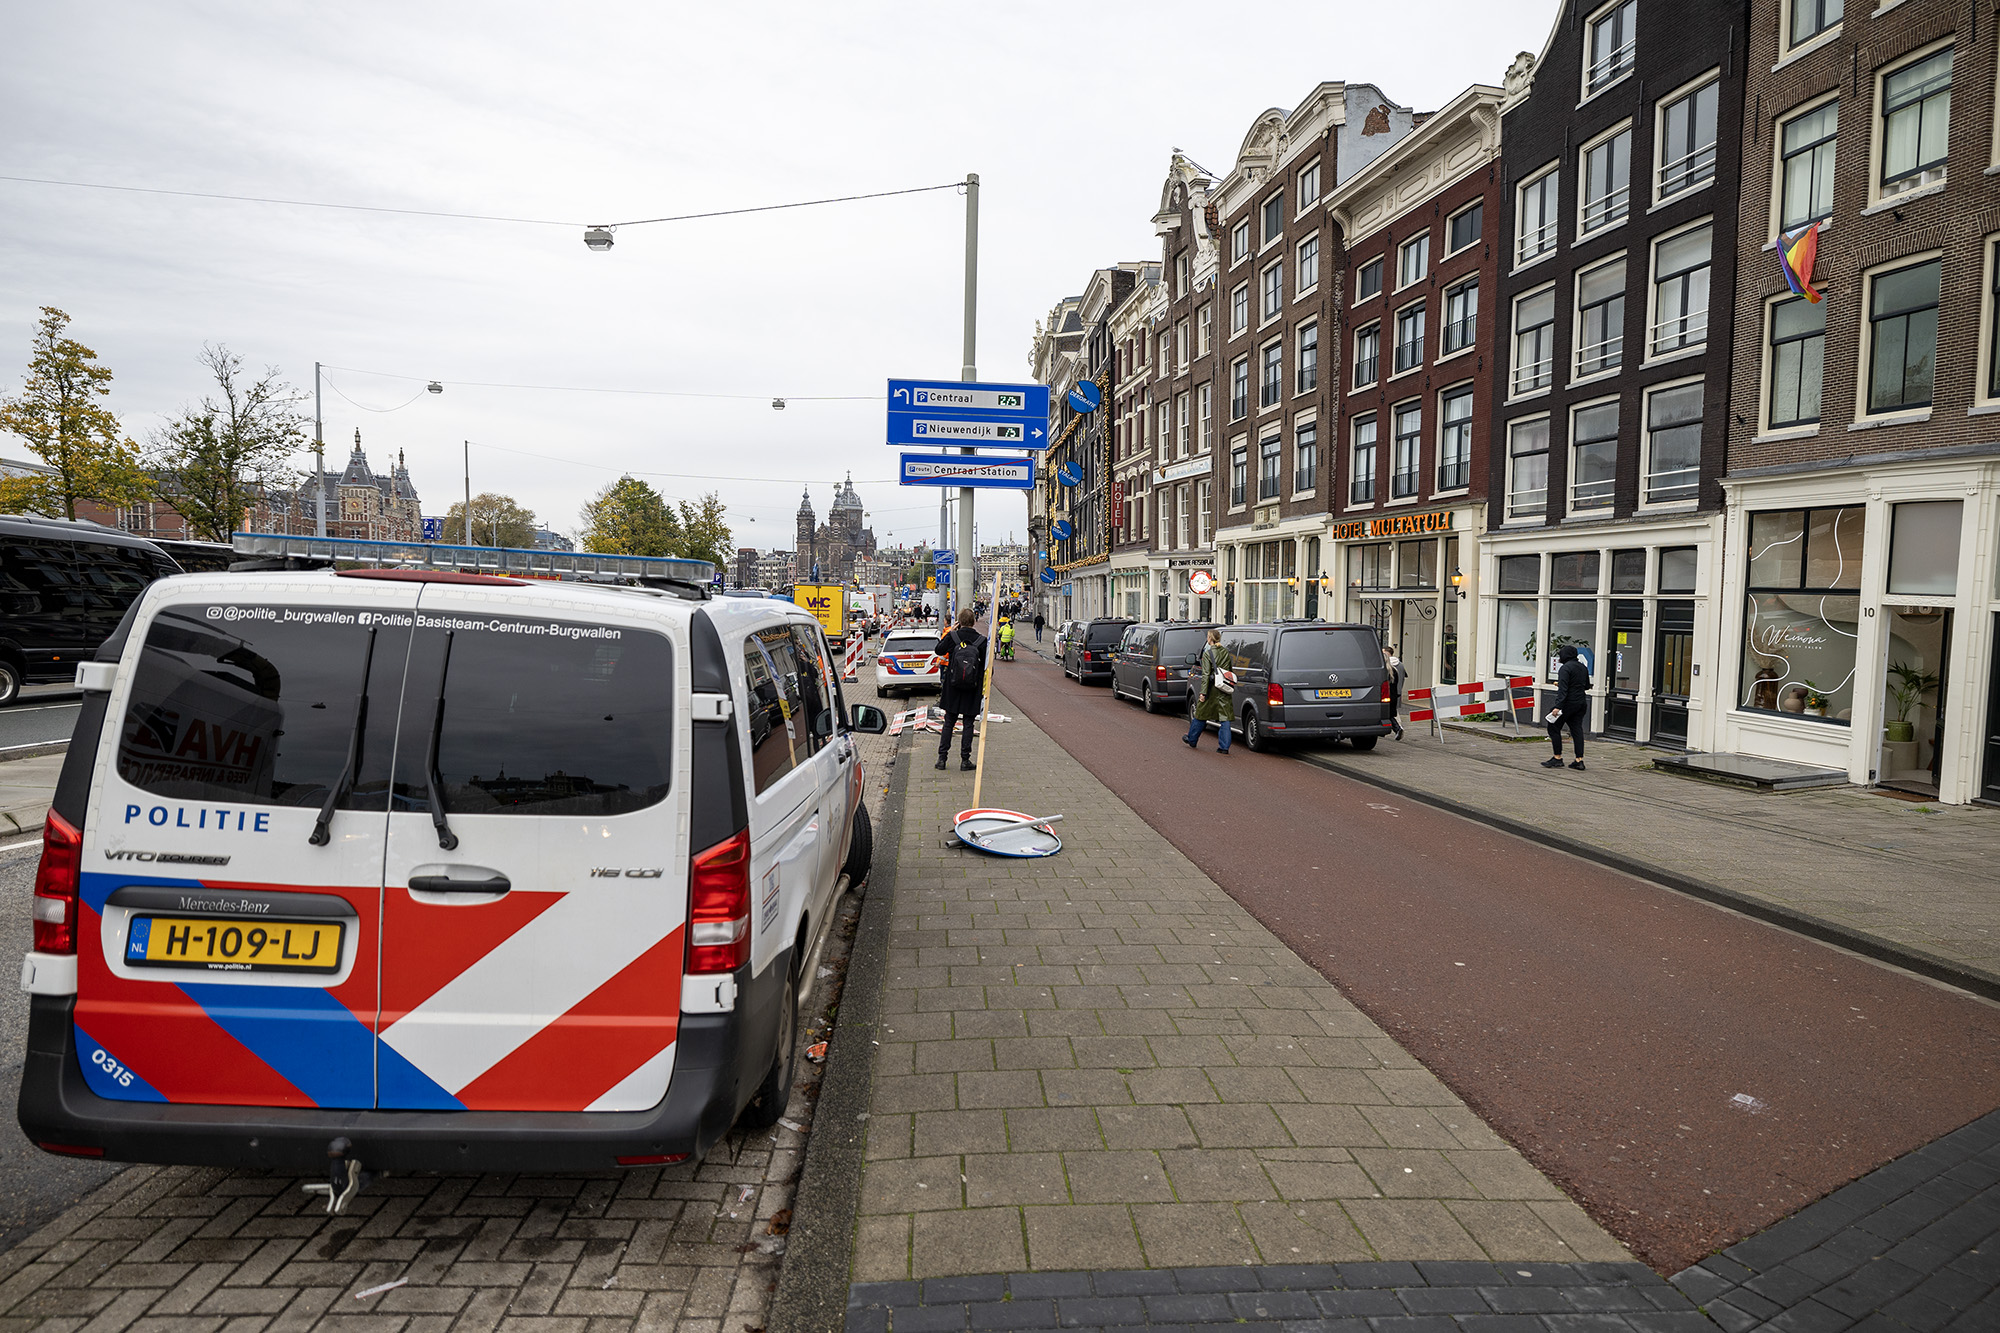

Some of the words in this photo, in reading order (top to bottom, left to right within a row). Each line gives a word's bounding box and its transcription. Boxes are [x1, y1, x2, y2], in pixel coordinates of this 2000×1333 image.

[930, 392, 973, 403] Centraal
[929, 424, 991, 437] Nieuwendijk
[934, 465, 977, 475] Centraal
[980, 467, 1017, 476] Station
[1058, 469, 1079, 484] ETALAGE
[1114, 483, 1122, 527] HOTEL
[1052, 527, 1069, 538] DISPLAY
[1333, 521, 1366, 540] HOTEL
[1369, 511, 1453, 537] MULTATULI
[806, 597, 831, 608] VHC
[223, 606, 354, 625] @politie_burgwallen
[1864, 607, 1875, 618] 10
[372, 613, 412, 627] Politie
[416, 615, 621, 640] Basisteam-Centrum-Burgwallen
[124, 804, 270, 833] POLITIE
[104, 849, 157, 862] VITO
[157, 853, 227, 865] TOURER
[624, 867, 664, 878] CDI
[178, 896, 270, 914] Mercedes-Benz
[131, 943, 145, 953] NL
[166, 924, 320, 960] H-109-LJ
[208, 963, 252, 971] www.politie.nl
[92, 1049, 134, 1087] 0315
